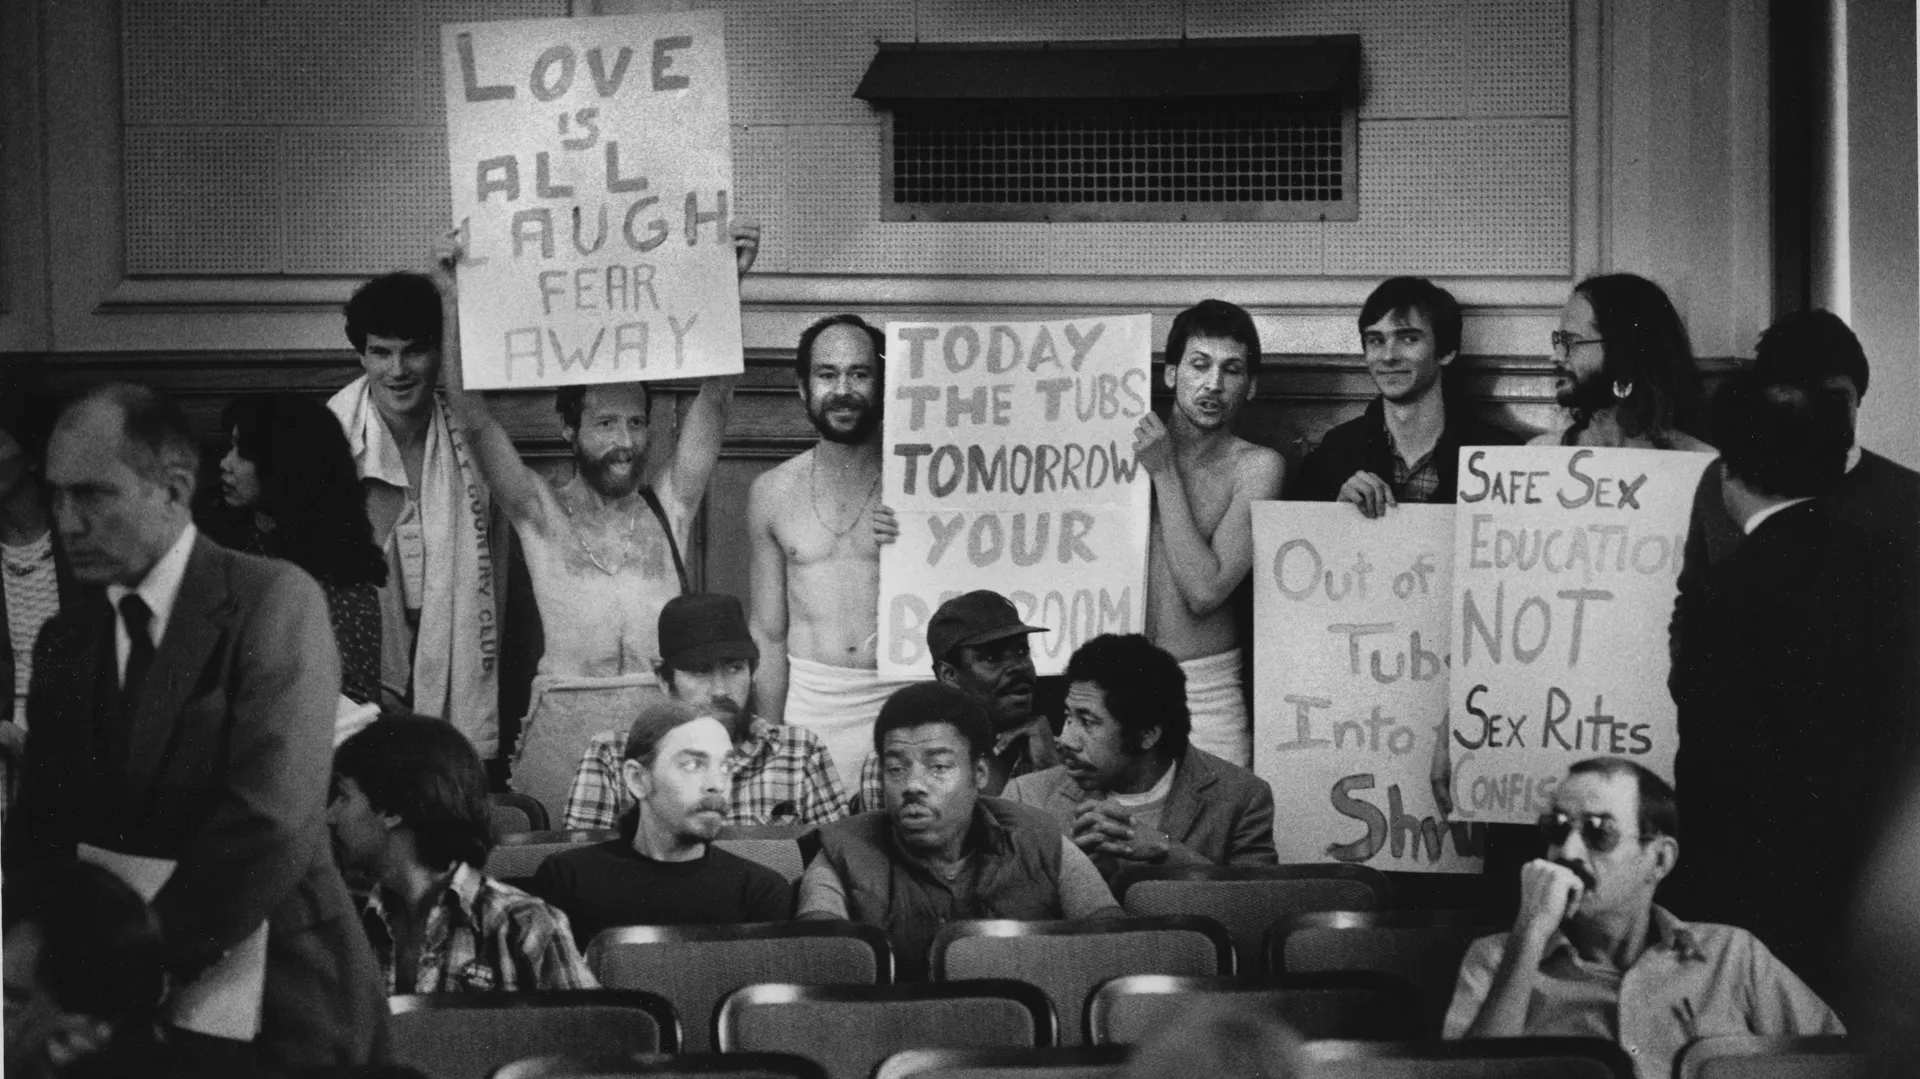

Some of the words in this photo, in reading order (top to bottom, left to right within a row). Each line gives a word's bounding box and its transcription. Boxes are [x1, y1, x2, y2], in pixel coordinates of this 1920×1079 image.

[456, 32, 693, 102] LOVE
[558, 107, 599, 150] IS
[476, 141, 648, 202] ALL
[538, 263, 660, 315] FEAR
[503, 314, 698, 381] AWAY
[898, 322, 1106, 380] TODAY
[896, 383, 1016, 431] THE
[1034, 368, 1147, 423] TUBS
[893, 440, 1140, 498] TOMORROW
[1459, 451, 1550, 503] SAFE
[1556, 450, 1648, 510] SEX
[466, 484, 492, 597] COUNTRY
[926, 509, 1099, 568] YOUR
[1273, 539, 1374, 601] Out
[1392, 552, 1436, 599] of
[478, 608, 497, 672] CLUB
[1327, 620, 1452, 684] Tub
[1462, 580, 1615, 668] NOT
[1276, 693, 1416, 756] Into
[1453, 684, 1527, 751] SEX
